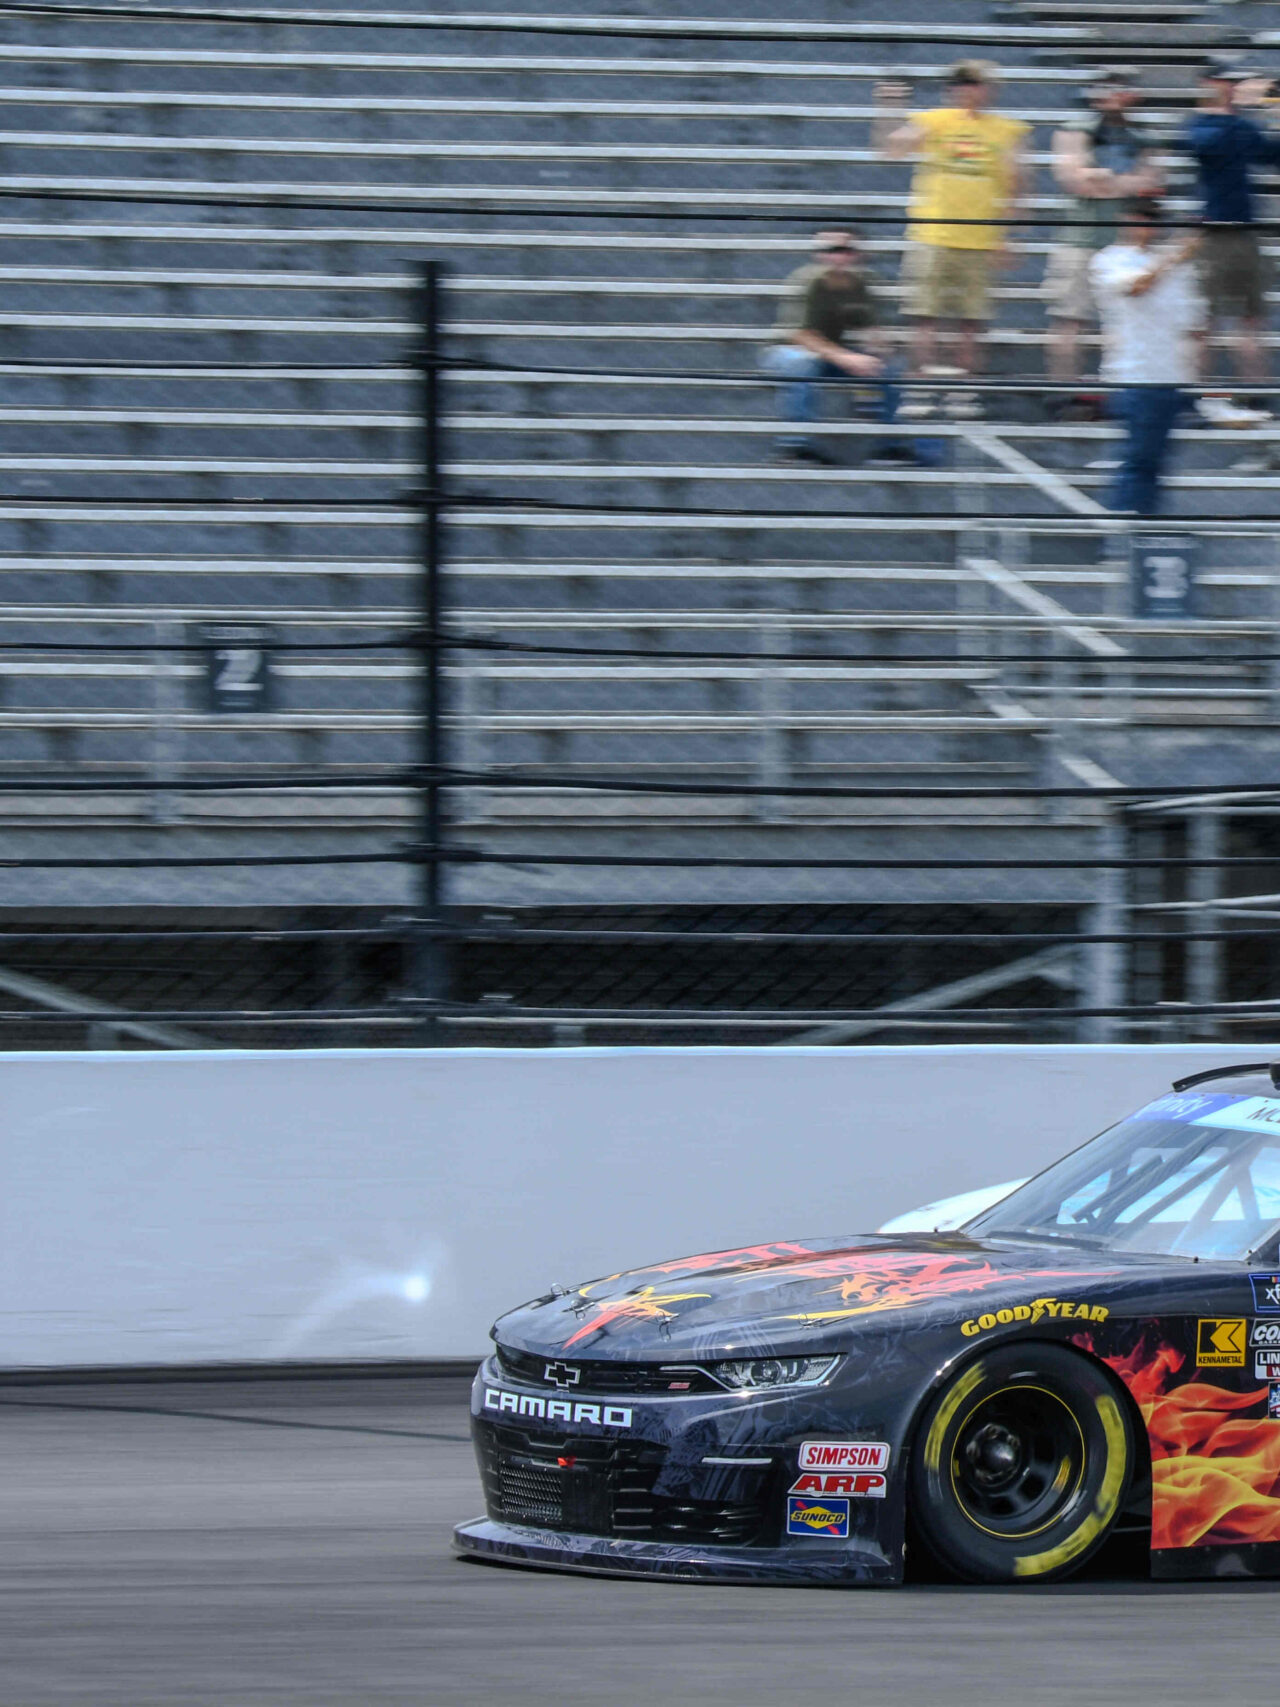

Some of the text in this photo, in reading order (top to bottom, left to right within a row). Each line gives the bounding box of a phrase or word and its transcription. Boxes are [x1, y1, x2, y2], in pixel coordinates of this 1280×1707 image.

[1144, 556, 1189, 598] 3
[214, 649, 263, 690] 2
[960, 1301, 1110, 1337] GOODYEAR
[1198, 1355, 1243, 1364] KENNAMETAL
[485, 1388, 633, 1428] CAMARO
[806, 1446, 882, 1466] SIMPSON
[793, 1475, 885, 1493] ARP
[793, 1511, 844, 1523] SUNOCO
